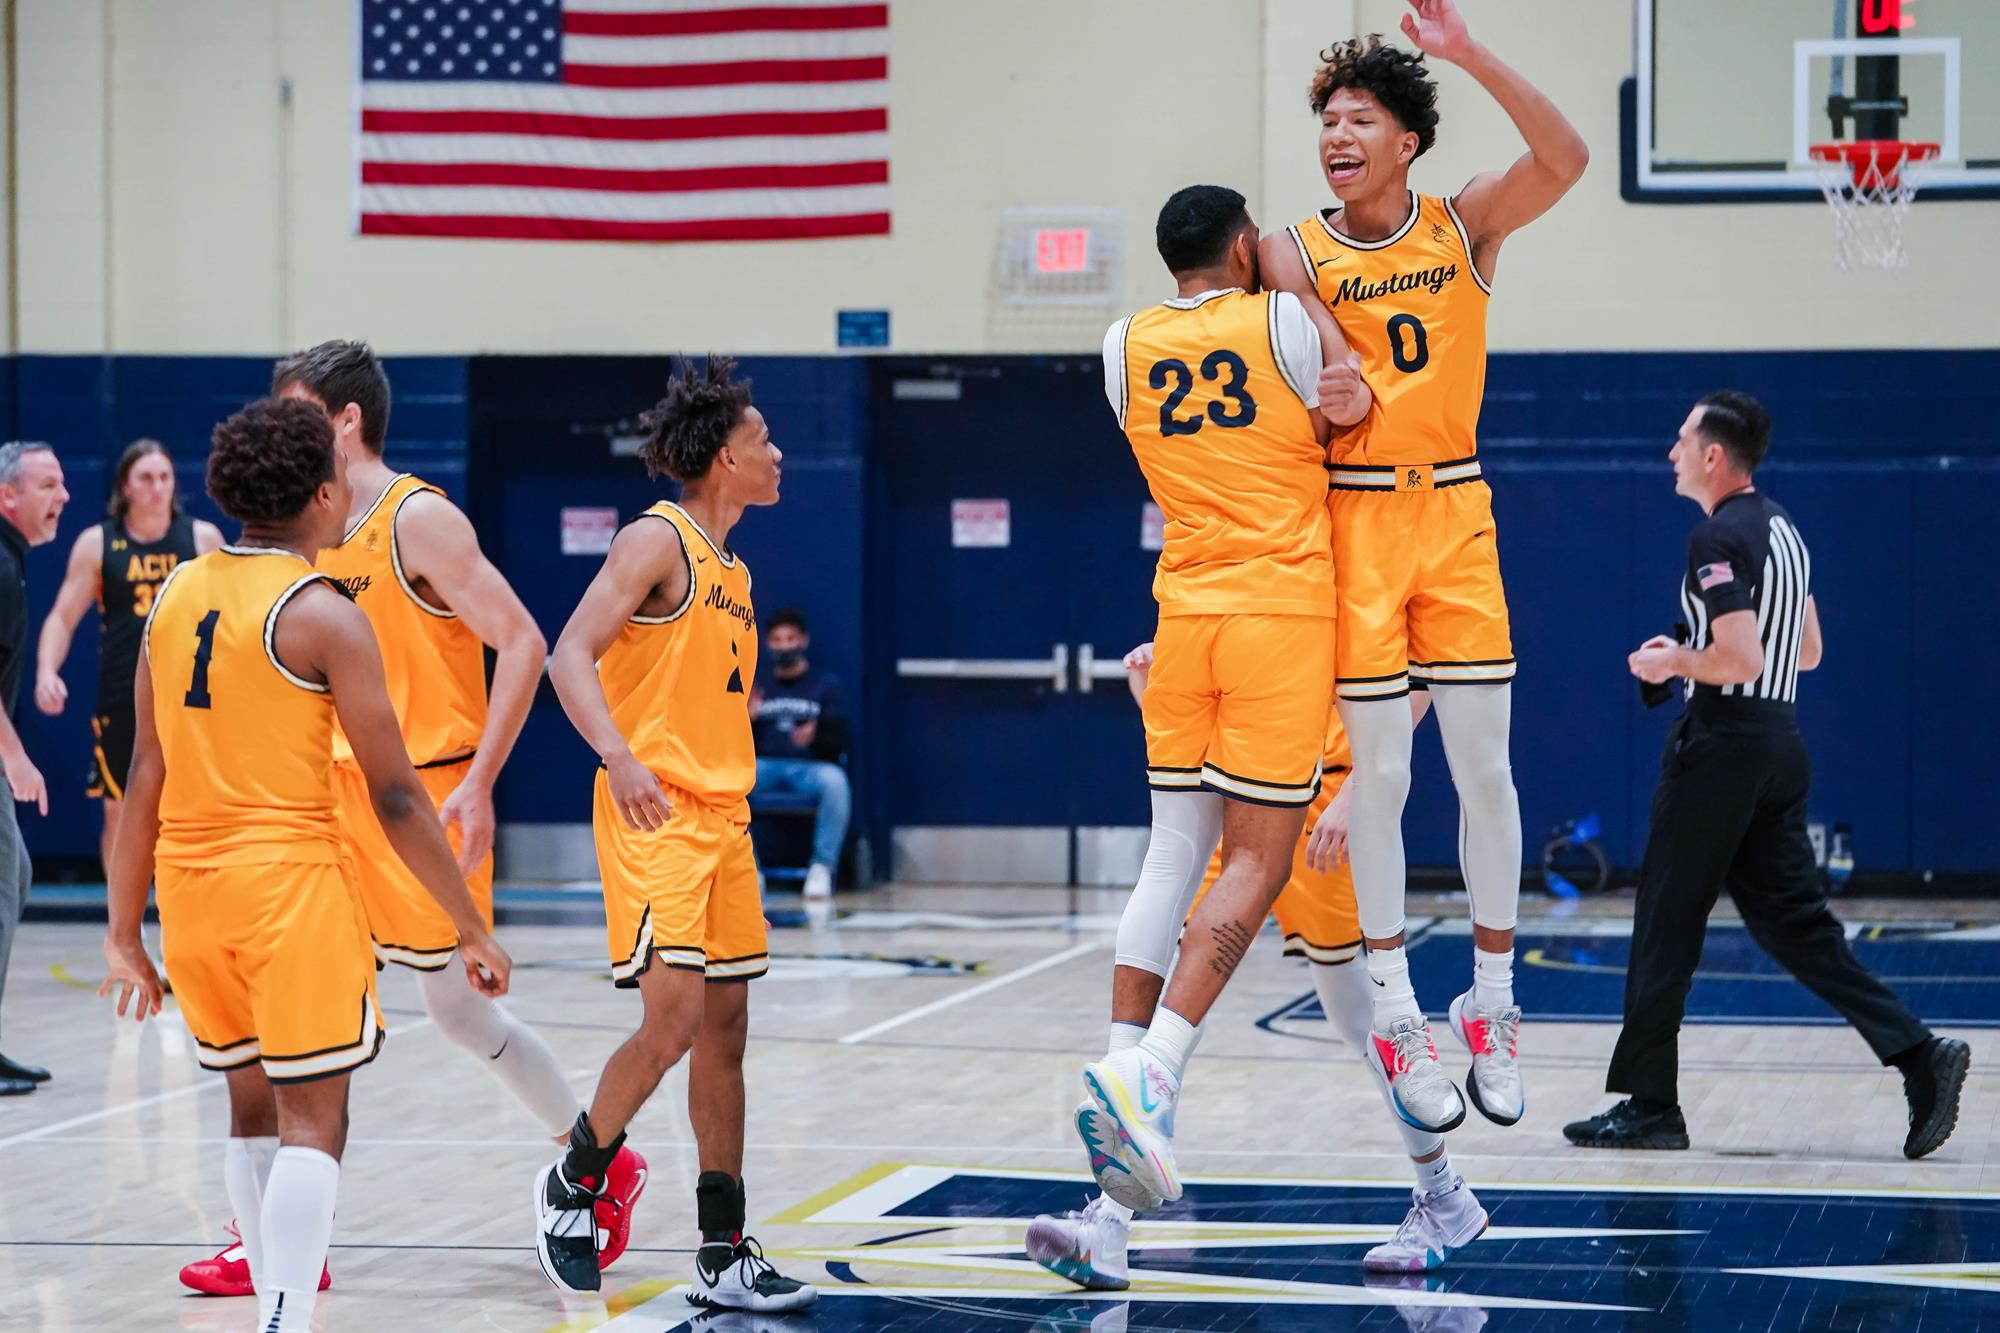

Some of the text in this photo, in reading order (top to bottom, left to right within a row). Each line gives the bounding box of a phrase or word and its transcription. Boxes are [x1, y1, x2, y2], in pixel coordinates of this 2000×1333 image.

[1331, 264, 1459, 308] Mustangs
[1387, 313, 1429, 373] 0
[1149, 349, 1257, 437] 23
[133, 583, 162, 617] 3
[184, 609, 221, 709] 1
